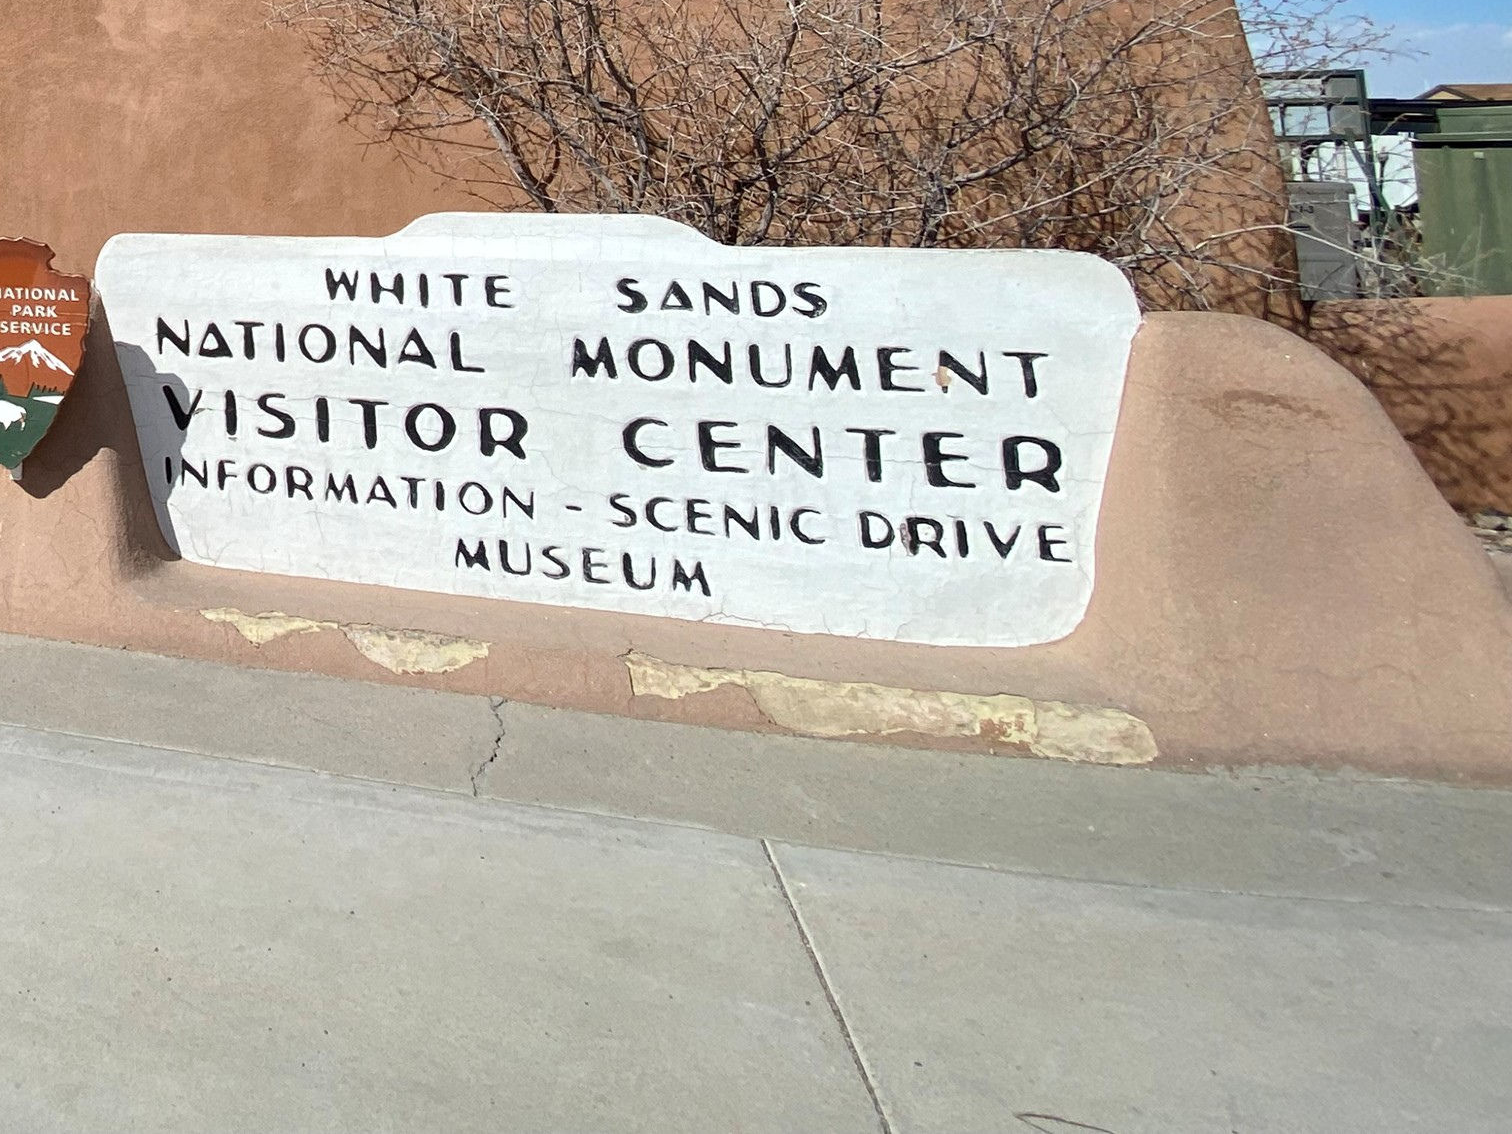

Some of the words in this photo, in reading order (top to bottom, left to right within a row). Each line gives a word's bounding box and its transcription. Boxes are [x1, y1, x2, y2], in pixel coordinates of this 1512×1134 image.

[12, 304, 58, 318] PARK
[325, 268, 515, 309] WHITE
[616, 278, 829, 319] SANDS
[0, 321, 72, 336] SERVICE
[157, 317, 486, 374] NATIONAL
[572, 336, 1050, 399] MONUMENT
[162, 384, 529, 460] VISITOR
[622, 418, 1063, 494] CENTER
[164, 456, 535, 520] INFORMATION
[608, 493, 826, 545] SCENIC
[859, 511, 1073, 563] DRIVE
[454, 538, 712, 597] MUSEUM
